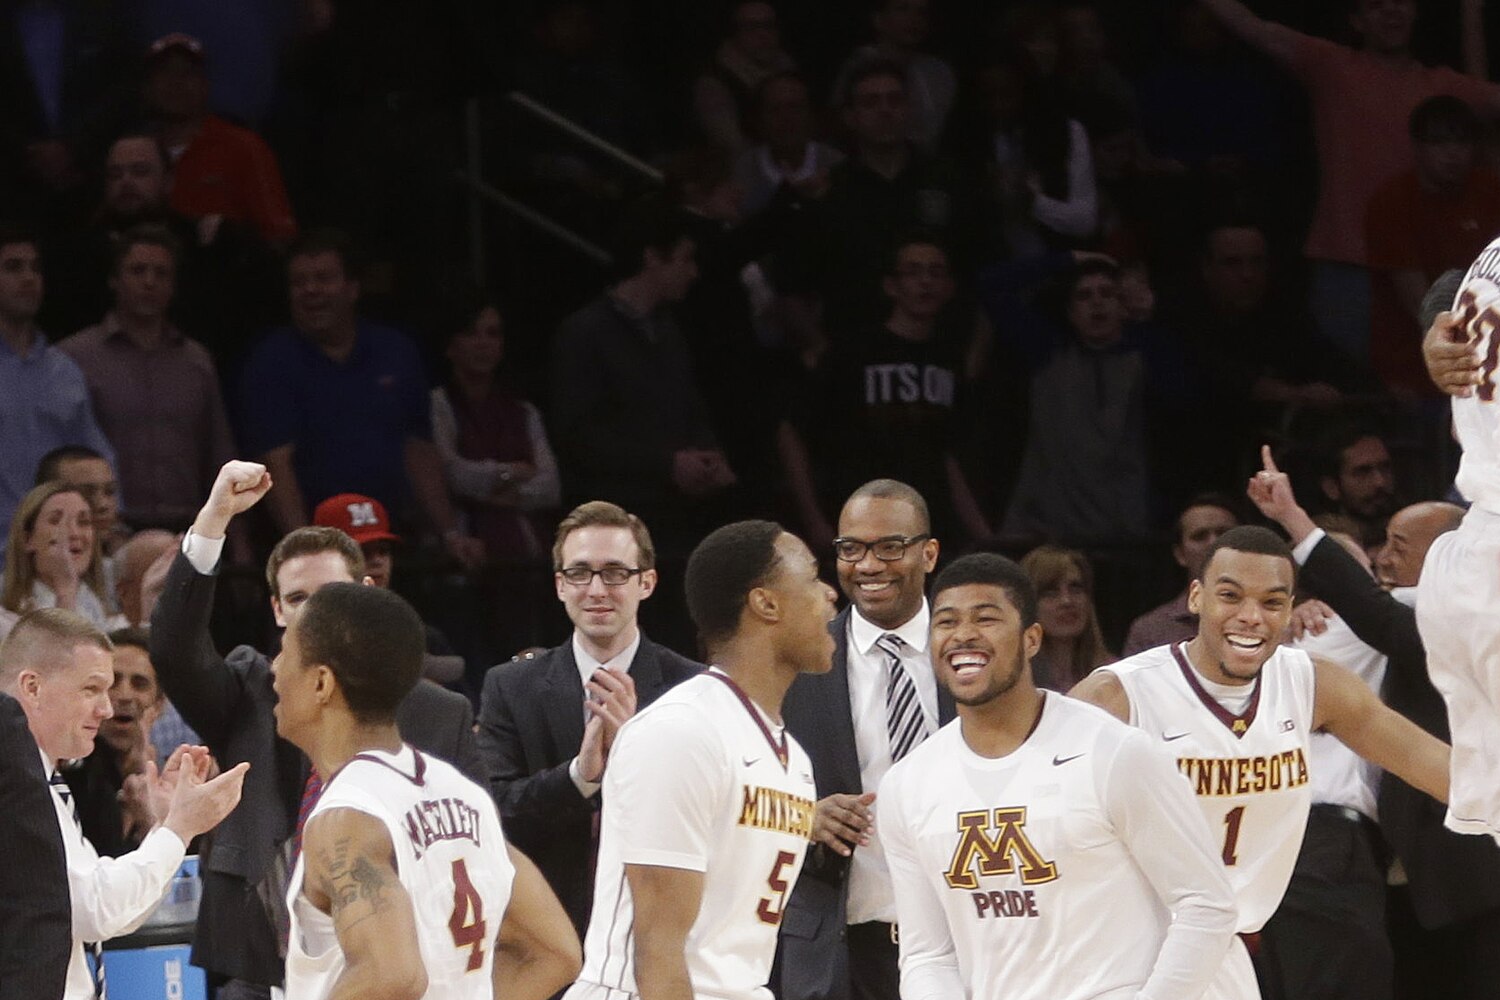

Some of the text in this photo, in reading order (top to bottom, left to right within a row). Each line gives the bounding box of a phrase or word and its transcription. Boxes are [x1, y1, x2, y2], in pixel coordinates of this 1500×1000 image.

[1176, 747, 1309, 797] INNESOTA
[943, 805, 1059, 890] M
[1220, 804, 1248, 869] 1
[448, 856, 487, 976] 4
[756, 849, 797, 927] 5
[971, 888, 1040, 919] PRIDE
